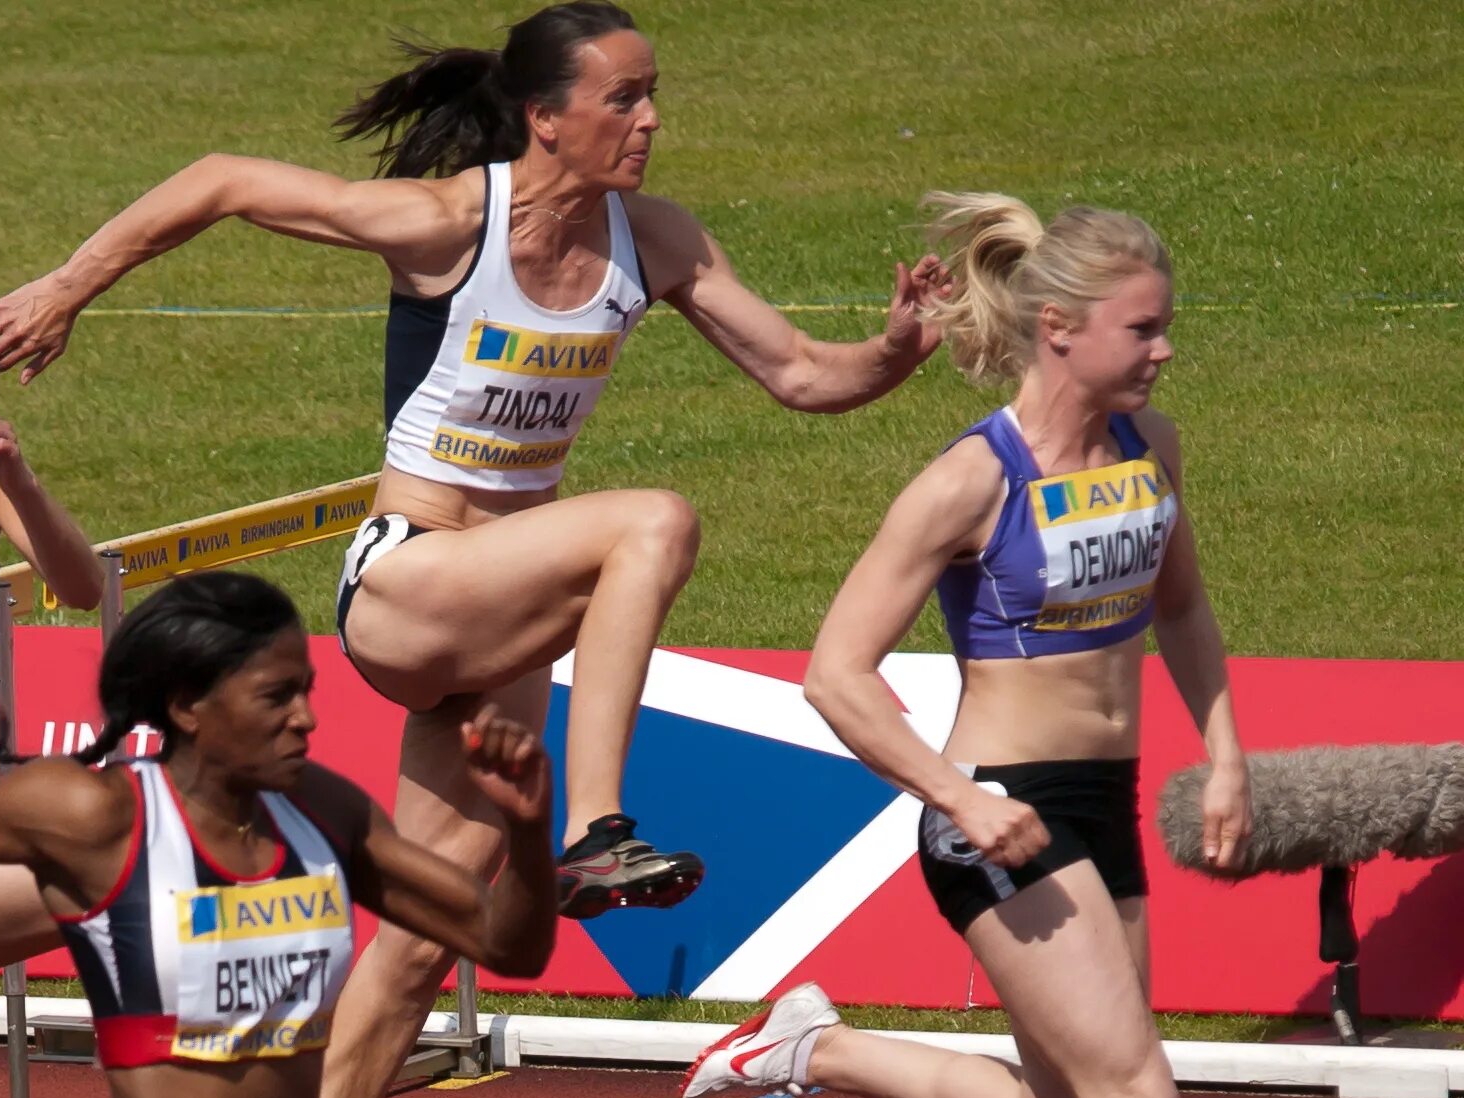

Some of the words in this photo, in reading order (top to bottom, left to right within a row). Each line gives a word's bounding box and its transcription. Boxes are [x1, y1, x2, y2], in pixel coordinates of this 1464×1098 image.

[522, 344, 608, 369] AVIVA
[1089, 472, 1163, 509] AVIV
[128, 547, 168, 573] AVIVA
[193, 533, 231, 557] AVIVA
[240, 514, 305, 546] BIRMINGHAM
[330, 499, 367, 521] AVIVA
[237, 891, 339, 929] AVIVA
[216, 948, 331, 1014] BENNETT
